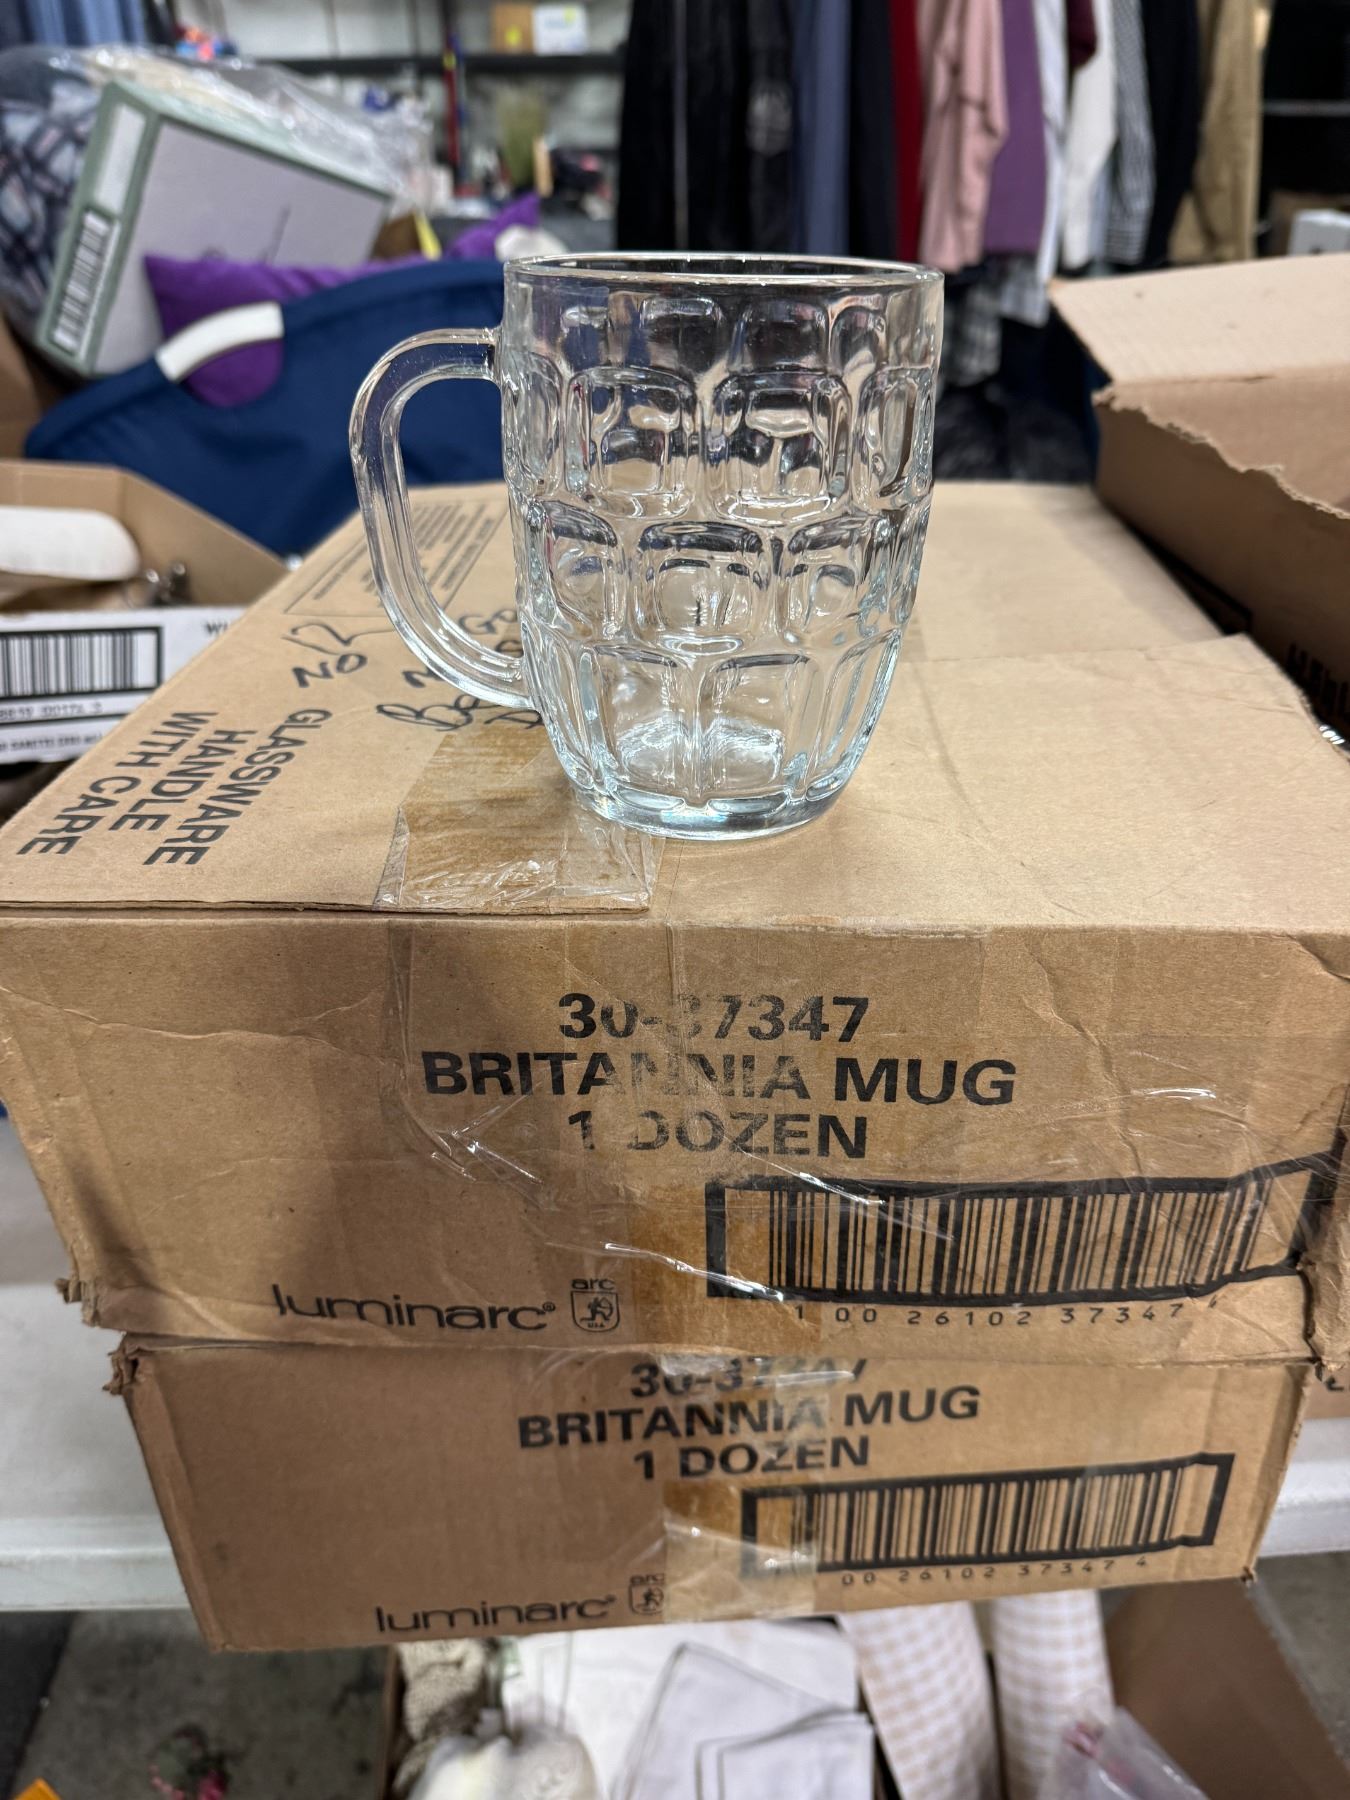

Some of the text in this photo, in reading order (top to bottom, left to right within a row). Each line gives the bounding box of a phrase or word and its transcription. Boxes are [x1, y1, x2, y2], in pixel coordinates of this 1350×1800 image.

[16, 711, 219, 855] WITH CARE
[108, 729, 257, 831] HANDLE
[143, 709, 332, 865] GLASSWARE
[421, 1050, 1017, 1106] BRITANNIA MUG
[568, 1110, 867, 1159] 1 DOZEN
[571, 1278, 615, 1290] arc
[518, 1385, 980, 1449] BRITANNIA MUG
[633, 1435, 870, 1480] 1 DOZEN
